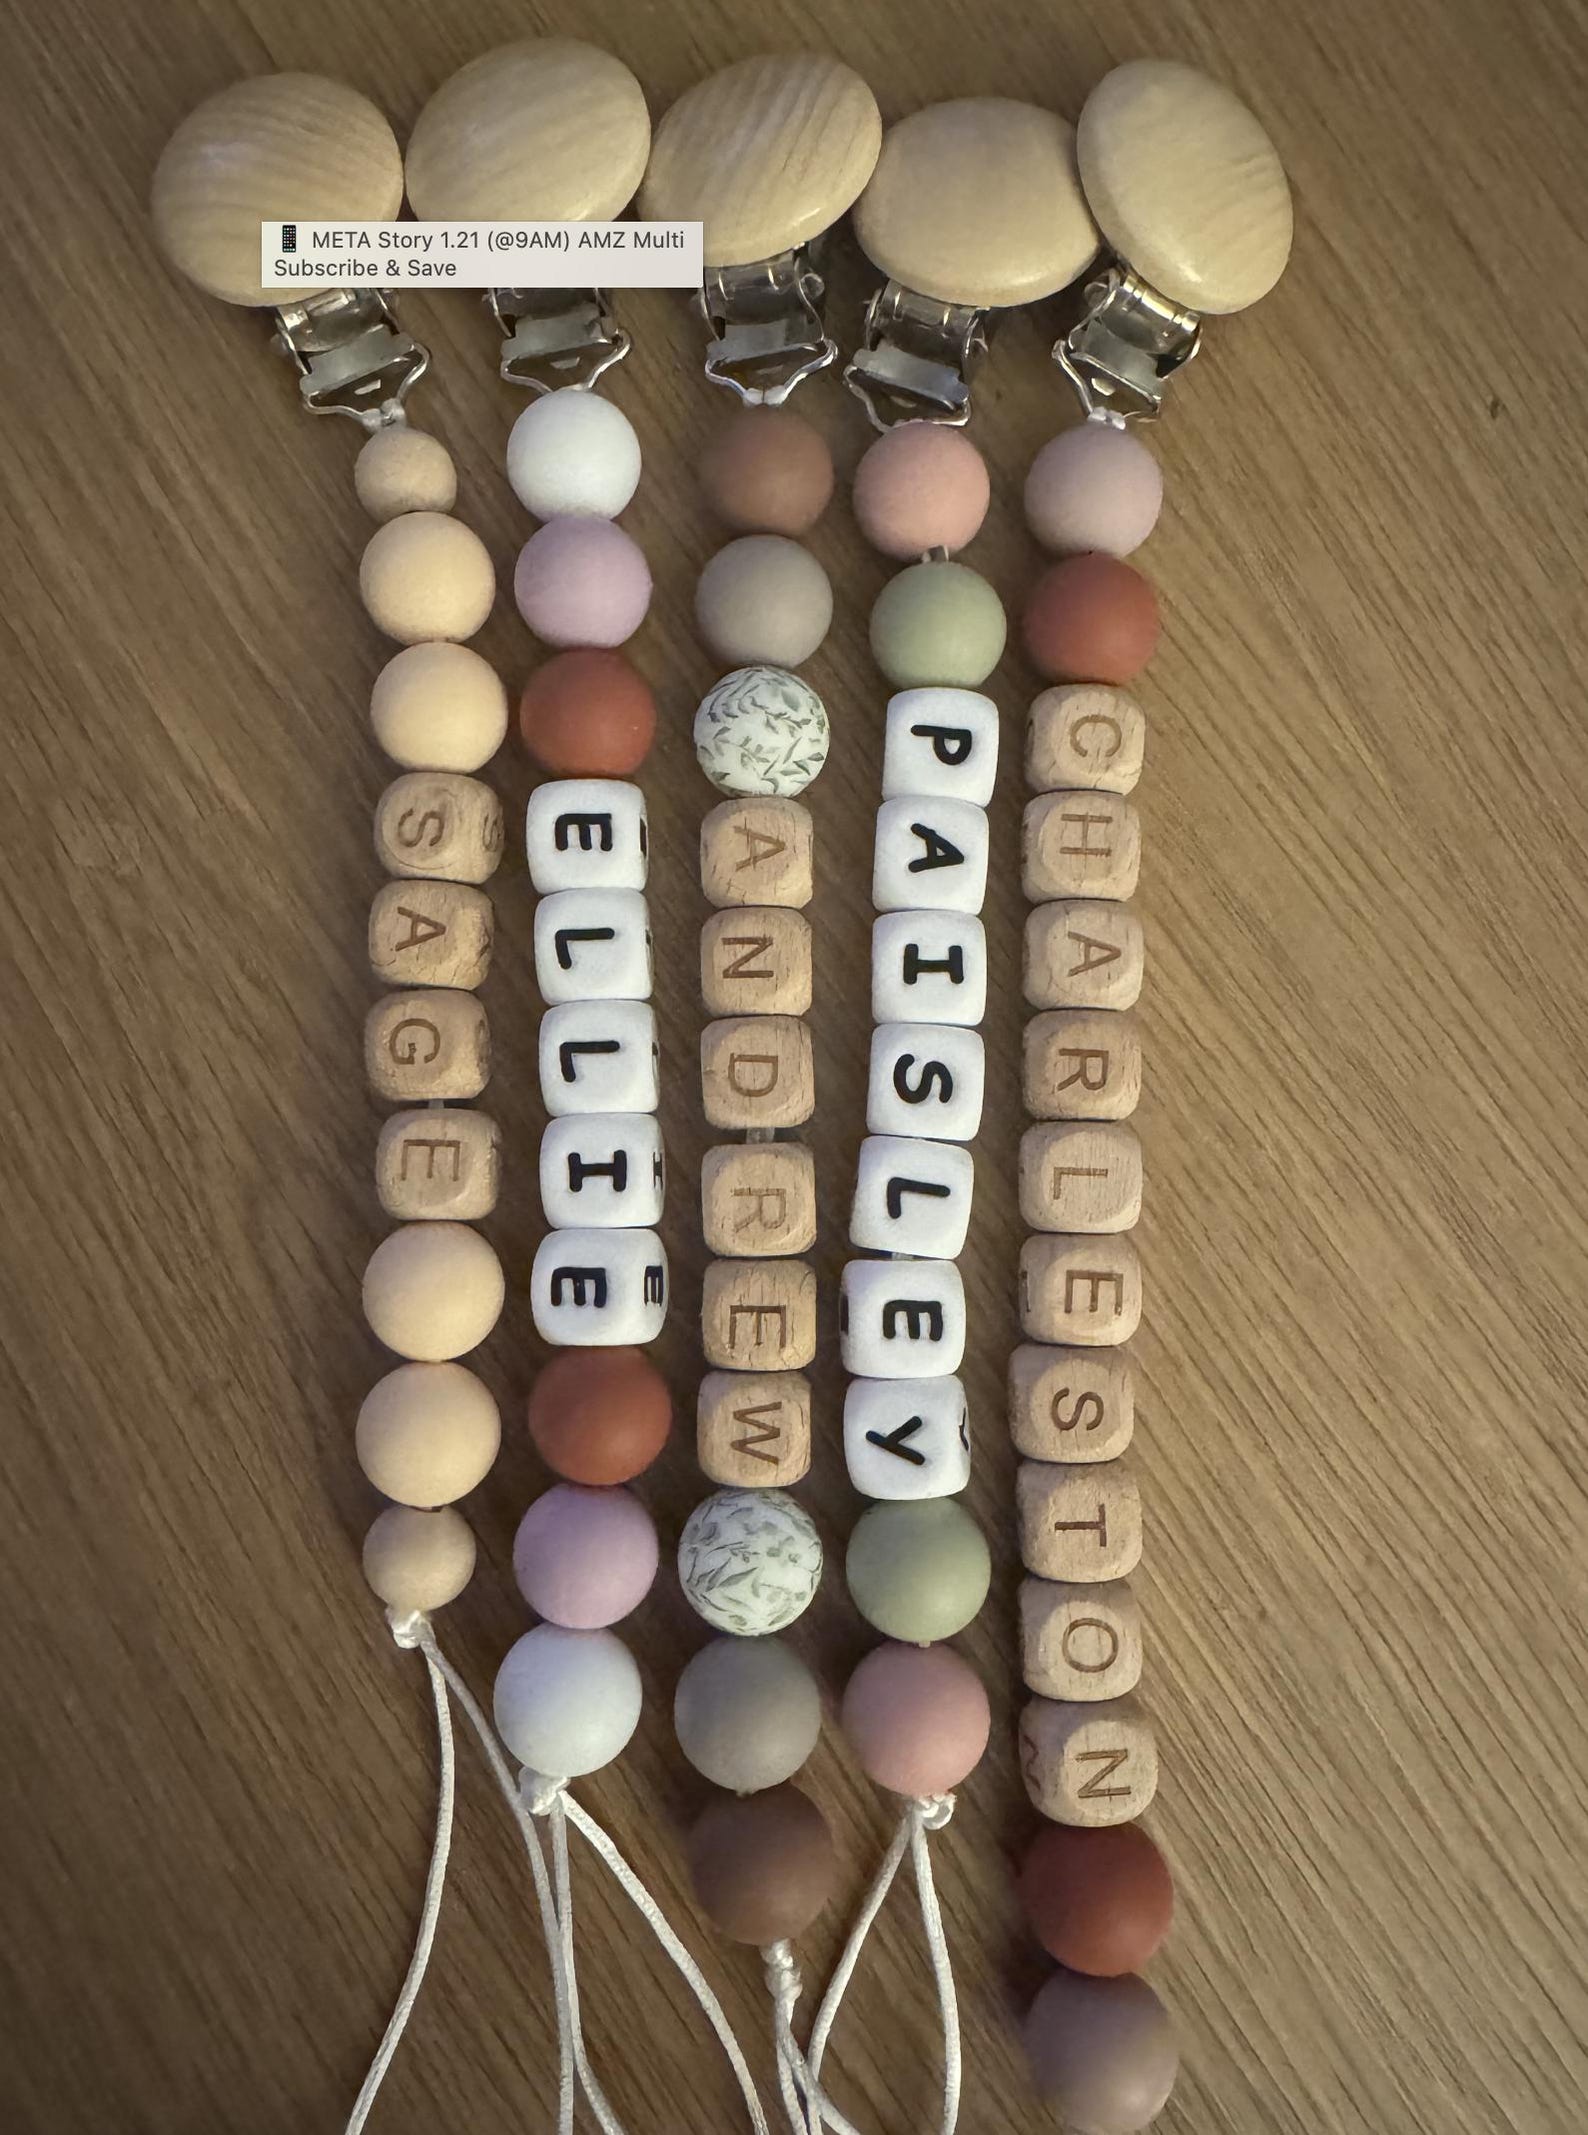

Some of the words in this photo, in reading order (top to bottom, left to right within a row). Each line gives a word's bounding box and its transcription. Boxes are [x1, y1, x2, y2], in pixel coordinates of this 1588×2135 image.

[388, 807, 461, 1183] SAGE
[550, 812, 627, 1308] ELLIE
[722, 824, 787, 1467] ANDREW
[865, 724, 973, 1466] PAISLEY
[1050, 713, 1132, 1799] CHARLESTON
